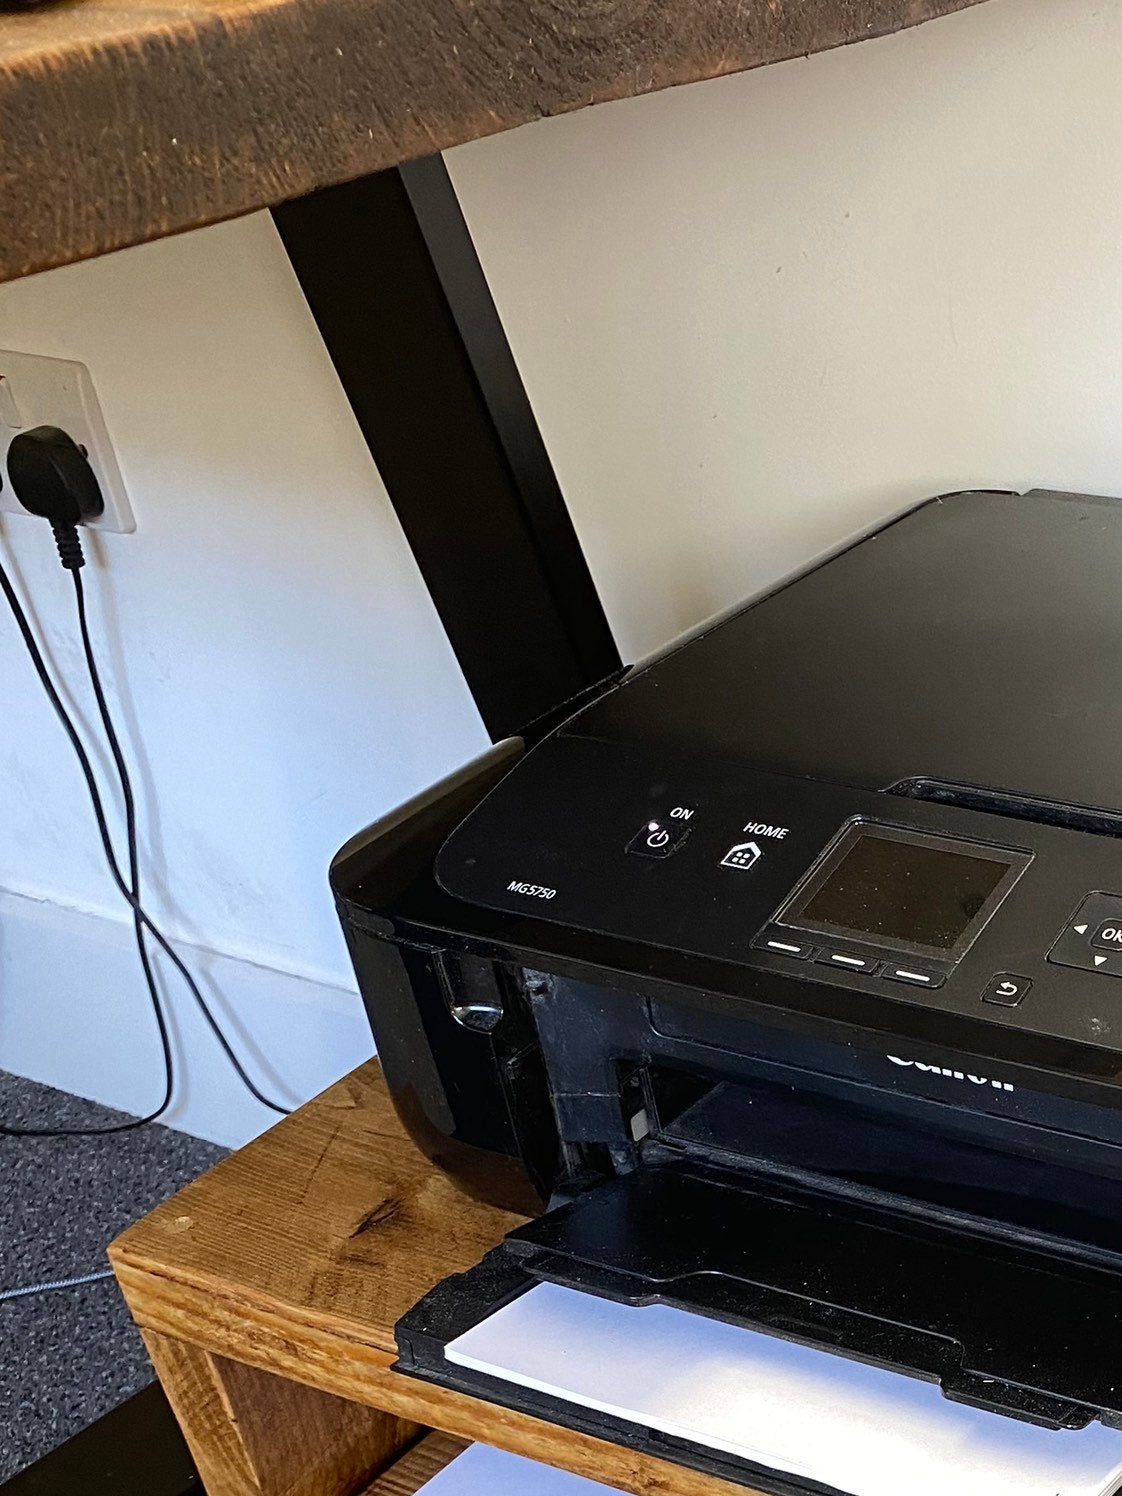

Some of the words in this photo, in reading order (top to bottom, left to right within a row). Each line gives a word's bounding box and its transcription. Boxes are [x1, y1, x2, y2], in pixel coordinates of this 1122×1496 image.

[669, 806, 695, 820] ON
[743, 822, 789, 840] HOME
[506, 880, 557, 900] MG5750
